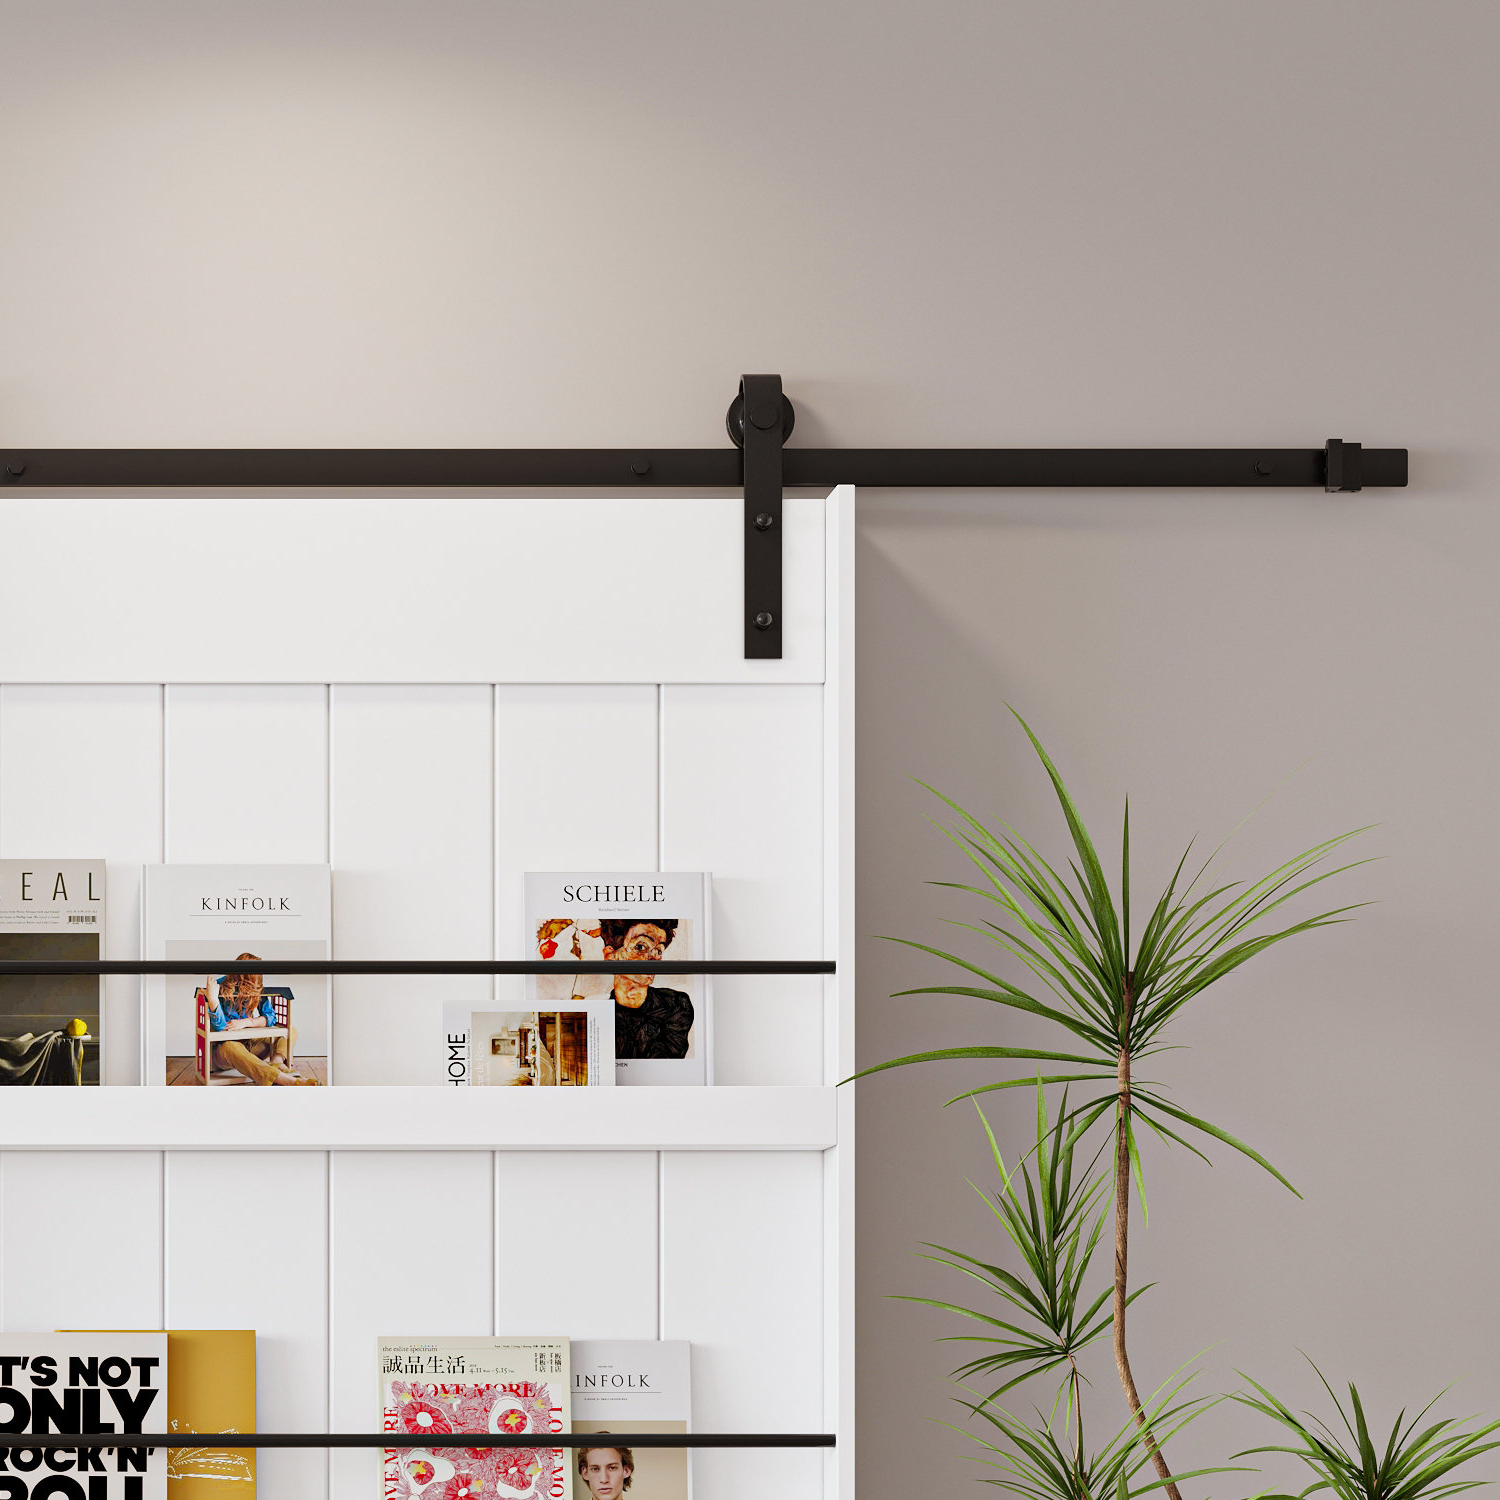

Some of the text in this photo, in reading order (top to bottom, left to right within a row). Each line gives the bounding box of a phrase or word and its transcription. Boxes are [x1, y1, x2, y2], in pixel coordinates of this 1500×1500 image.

[563, 885, 666, 903] SCHIELE
[202, 898, 290, 910] KINFOLK
[69, 1357, 159, 1387] NOT
[383, 1355, 465, 1374] 誠品生活
[572, 1374, 650, 1387] INFOLK
[384, 1407, 399, 1464] MRE
[548, 1407, 564, 1459] LOE
